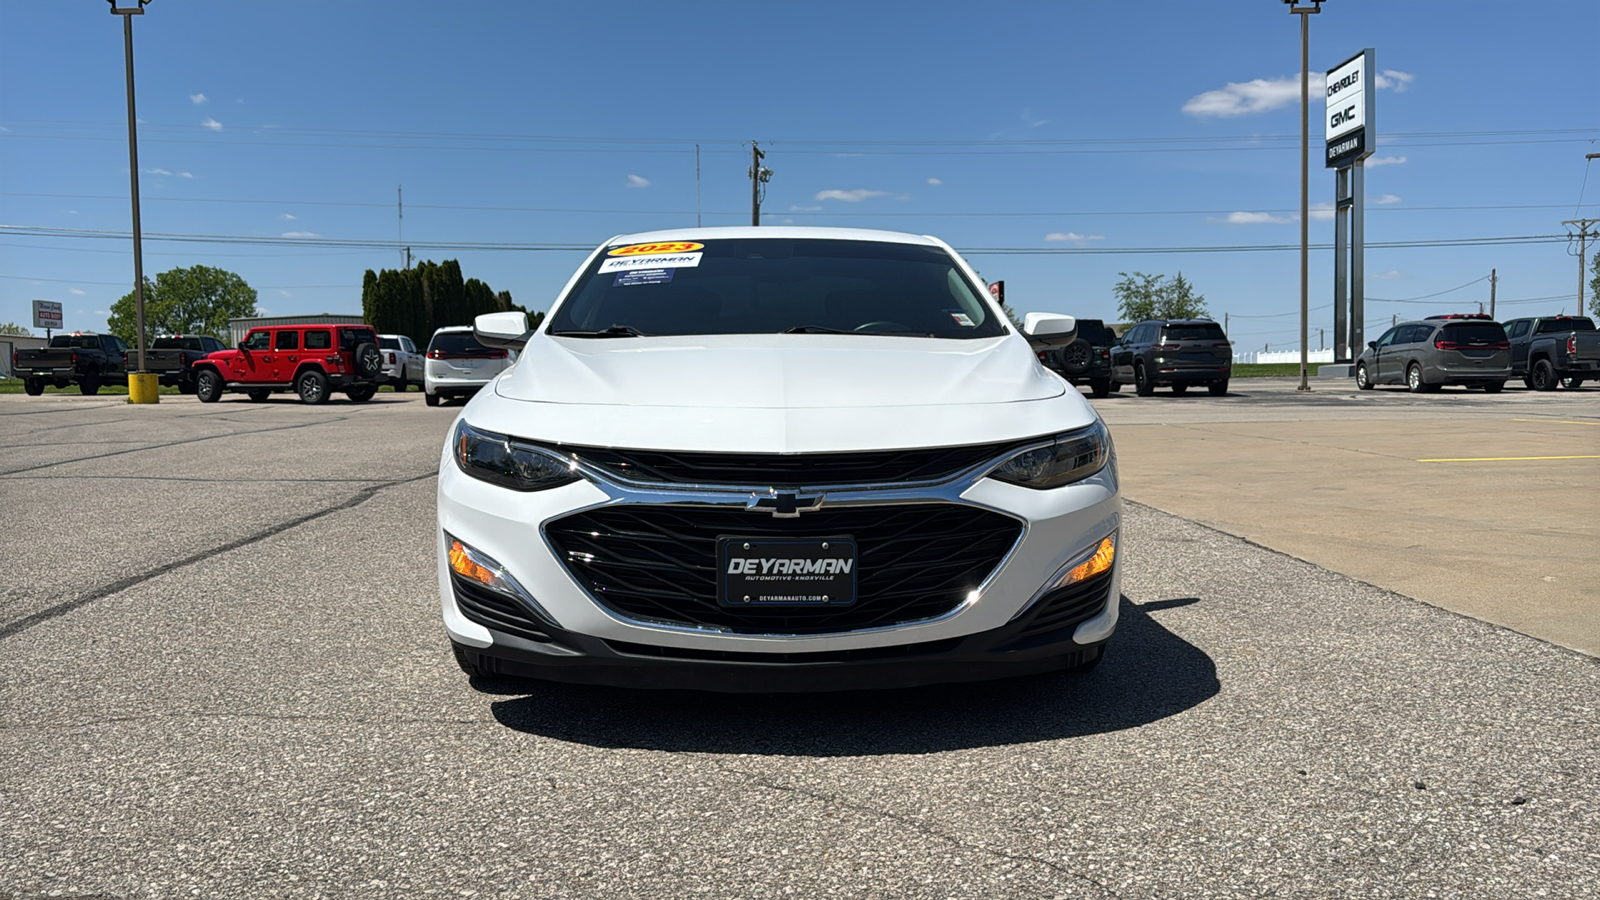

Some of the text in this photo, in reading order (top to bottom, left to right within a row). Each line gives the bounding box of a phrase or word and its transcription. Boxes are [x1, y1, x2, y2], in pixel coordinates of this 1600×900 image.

[1327, 70, 1359, 97] CHEVROLET
[1331, 105, 1355, 129] GMC
[1329, 138, 1358, 158] DEYARMAN
[617, 243, 695, 254] 2023
[608, 256, 696, 267] DEYARMAN
[727, 558, 853, 574] DEYARMAN
